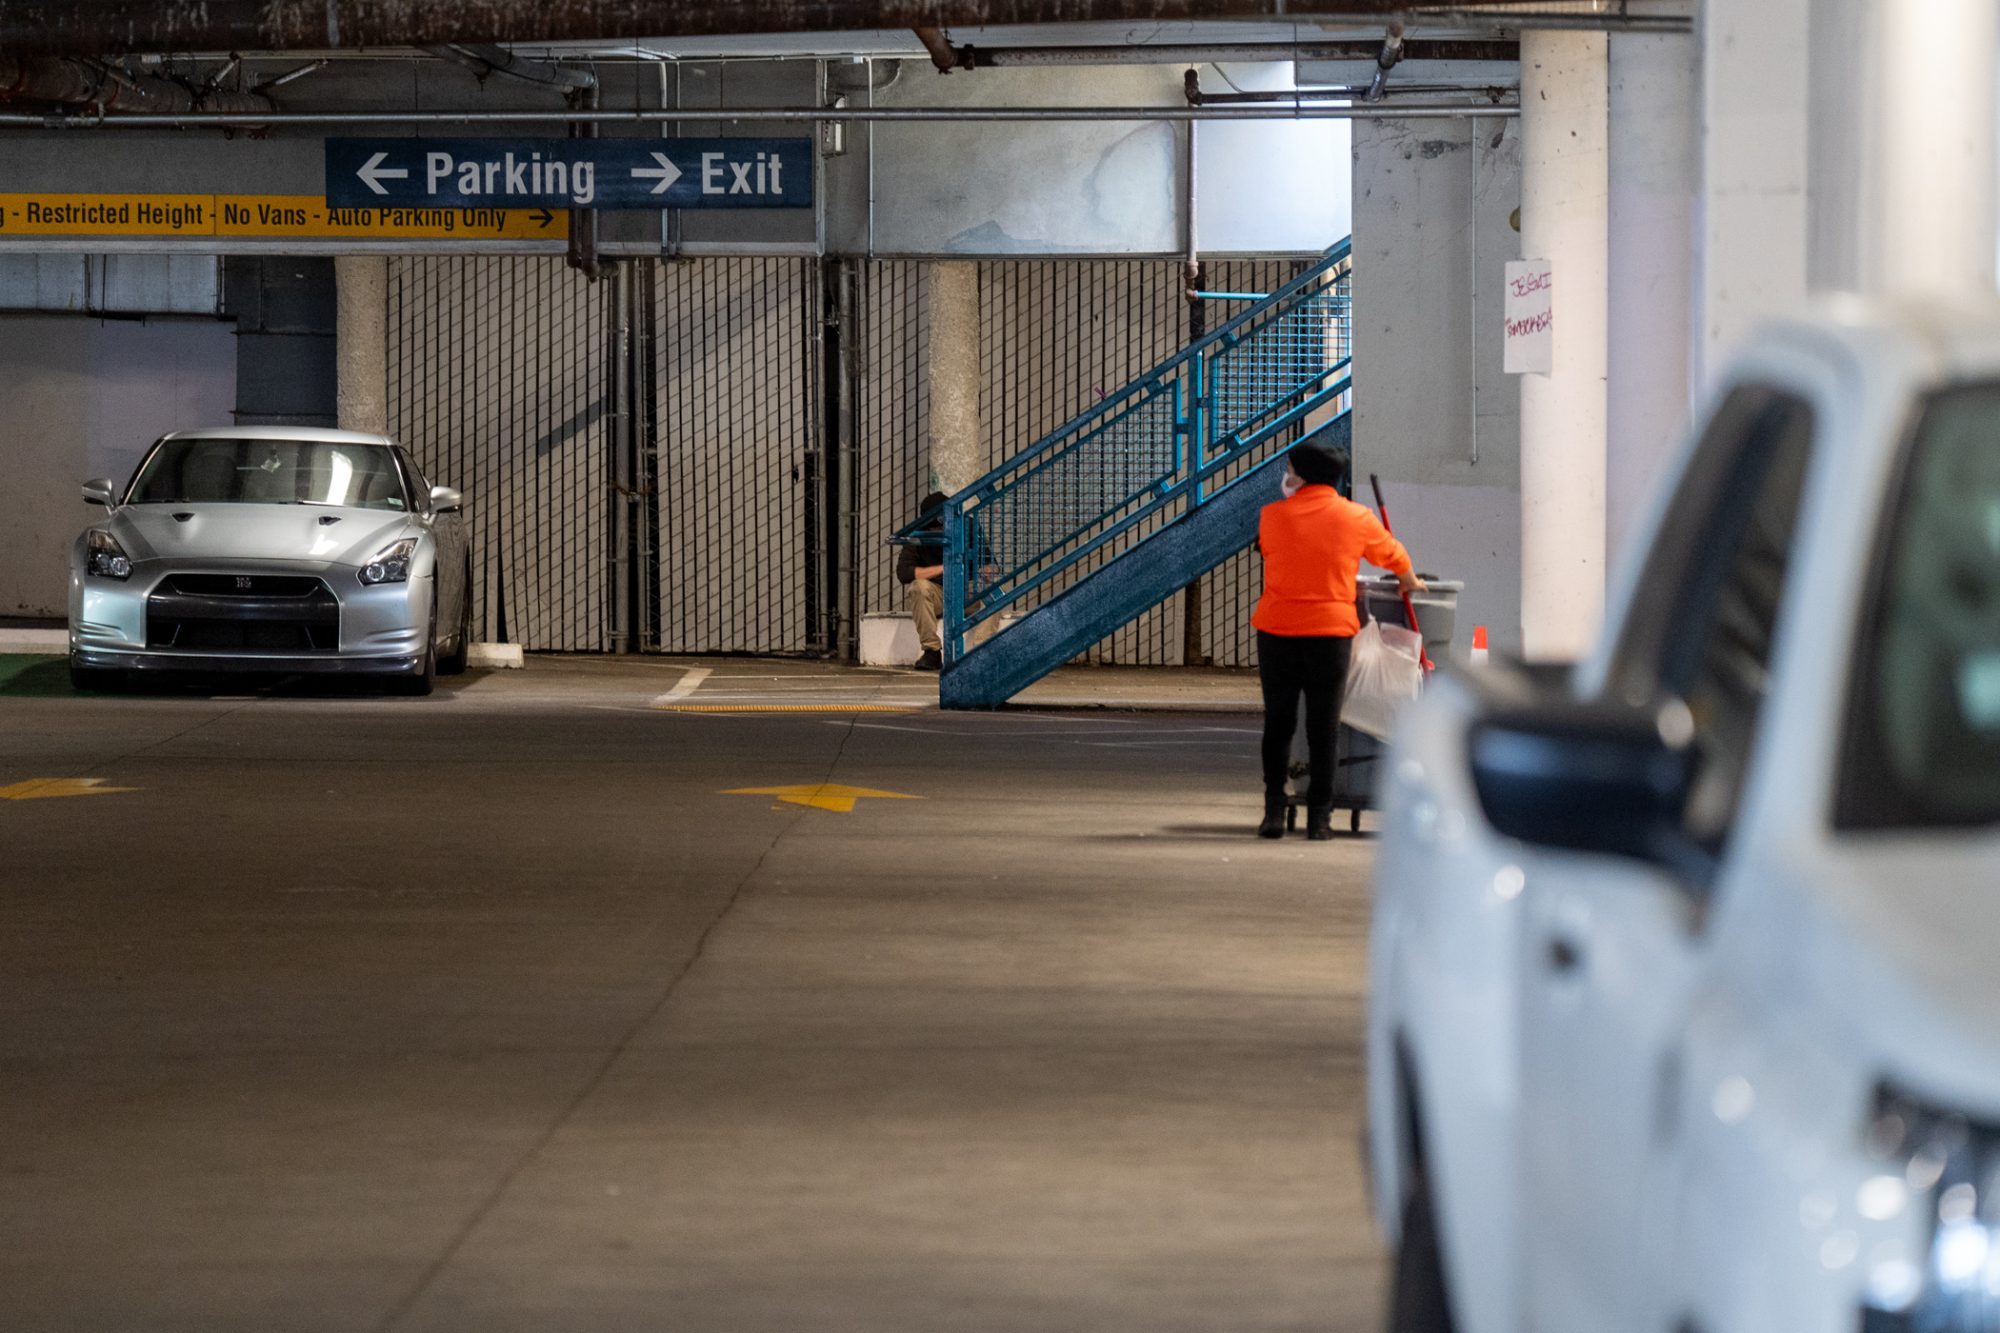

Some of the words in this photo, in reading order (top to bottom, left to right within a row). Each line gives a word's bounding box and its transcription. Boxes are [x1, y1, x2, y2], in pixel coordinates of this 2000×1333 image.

[426, 152, 595, 204] Parking
[701, 152, 783, 195] Exit
[27, 202, 129, 224] Restricted
[137, 203, 203, 228] Height
[225, 204, 251, 225] No
[258, 204, 307, 226] Vans
[327, 207, 372, 226] Auto
[379, 207, 455, 232] Parking
[463, 208, 507, 232] Only
